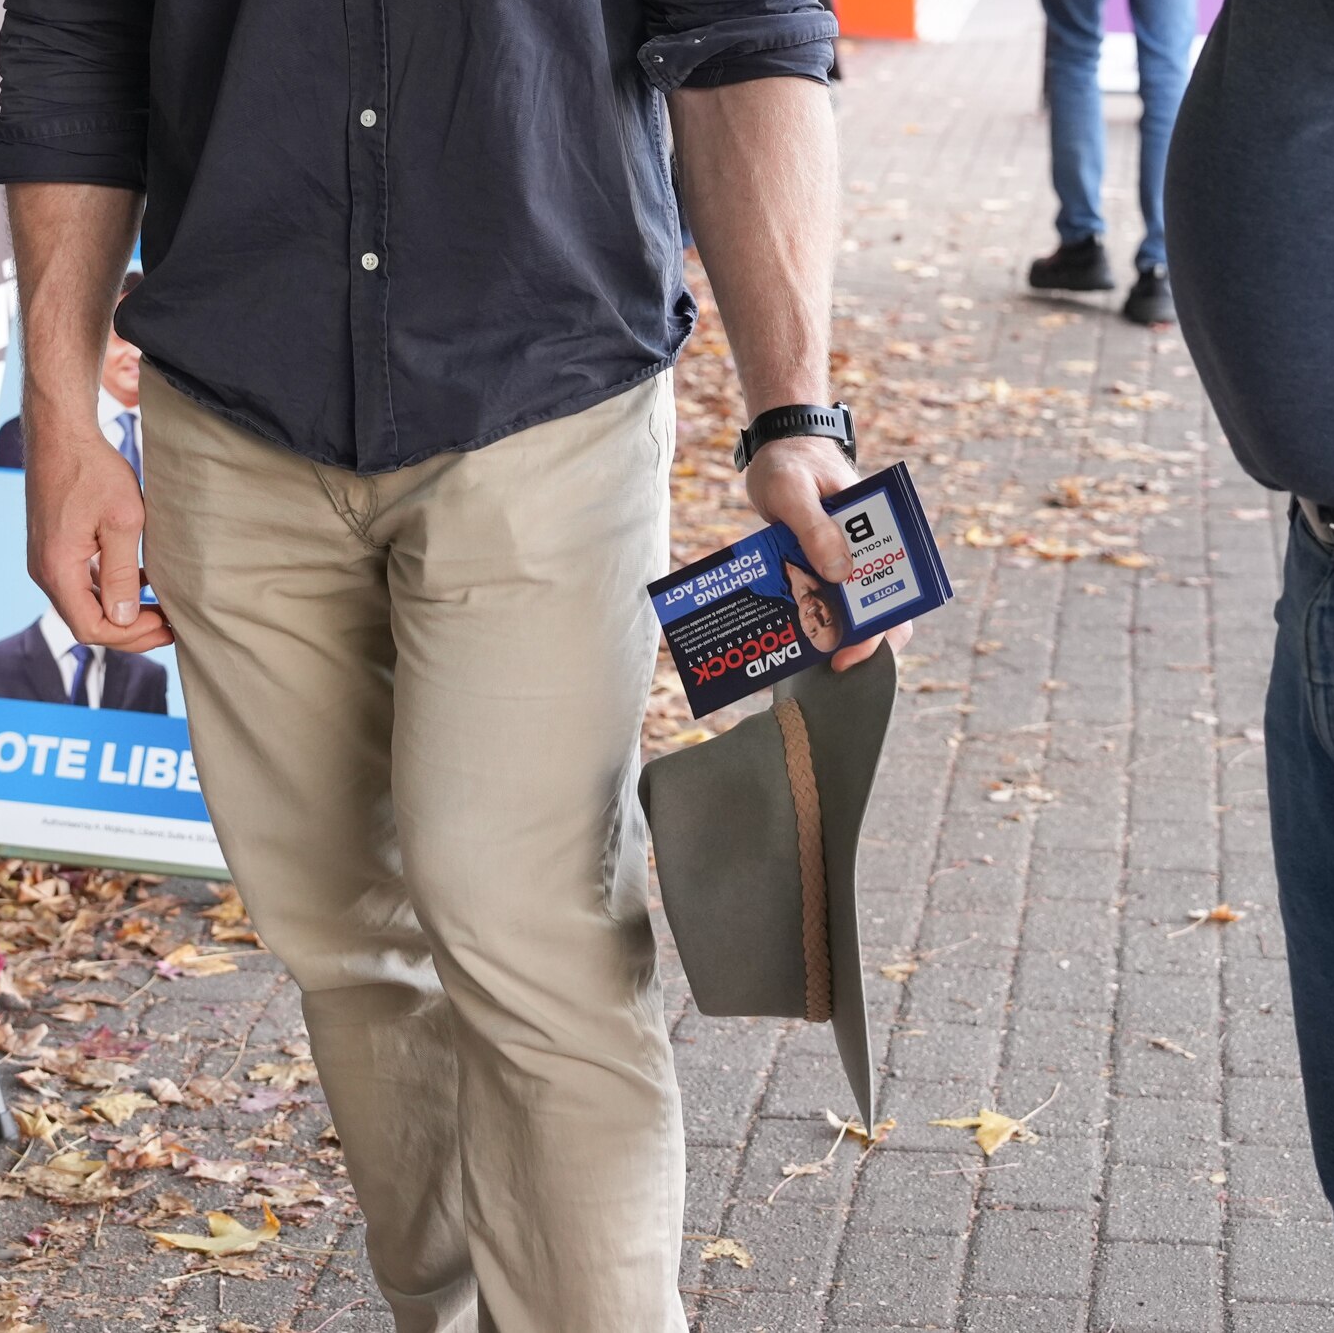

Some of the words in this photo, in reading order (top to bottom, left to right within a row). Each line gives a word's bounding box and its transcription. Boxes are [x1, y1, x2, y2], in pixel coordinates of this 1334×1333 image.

[845, 512, 875, 543] B
[883, 535, 893, 546] IN
[728, 550, 762, 574] FOR
[694, 563, 767, 606] FIGHTING
[696, 567, 728, 589] THE
[861, 566, 894, 587] DAVID
[665, 581, 693, 606] ACT
[867, 596, 872, 604] 1
[875, 584, 899, 600] VOTE
[715, 601, 737, 615] affordable
[737, 607, 756, 621] integrity
[689, 613, 712, 627] accessible
[707, 617, 719, 626] duty
[740, 614, 758, 627] housing
[715, 622, 742, 639] affordability
[684, 636, 713, 654] cost-of-living
[688, 615, 790, 667] INDEPENDENT
[691, 622, 797, 687] POCOCK
[746, 641, 802, 678] DAVID
[98, 742, 203, 793] LIBE
